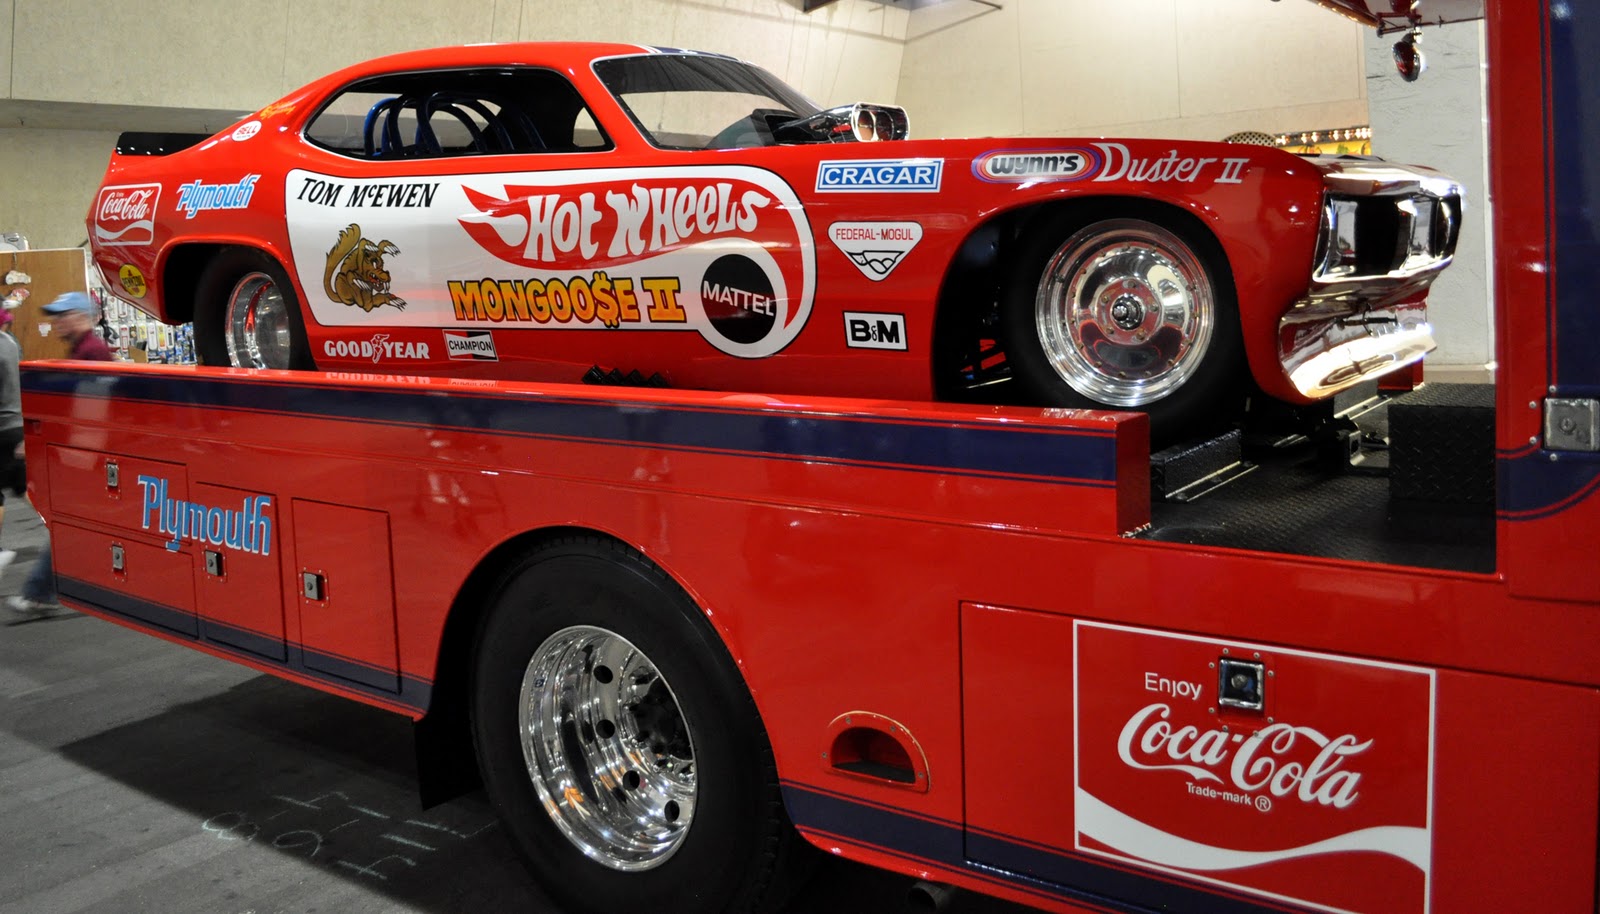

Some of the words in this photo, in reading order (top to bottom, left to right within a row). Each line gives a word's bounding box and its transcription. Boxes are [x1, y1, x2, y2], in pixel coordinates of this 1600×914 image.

[823, 166, 933, 185] CRAGAR
[1090, 142, 1216, 184] Duster
[1214, 158, 1251, 184] II
[100, 189, 154, 221] Coca-Cola
[176, 173, 262, 219] Plymouth
[297, 178, 344, 207] TOM
[836, 227, 914, 241] FEDERAL-MOGUL
[641, 276, 687, 323] II
[703, 280, 775, 317] MATTEL
[448, 339, 493, 352] CHAMPION
[849, 318, 900, 344] B&M
[137, 474, 271, 557] Plymouth
[1145, 672, 1202, 701] Enjoy
[1117, 703, 1373, 809] Coca-Cola
[1186, 782, 1252, 806] Trade-mark
